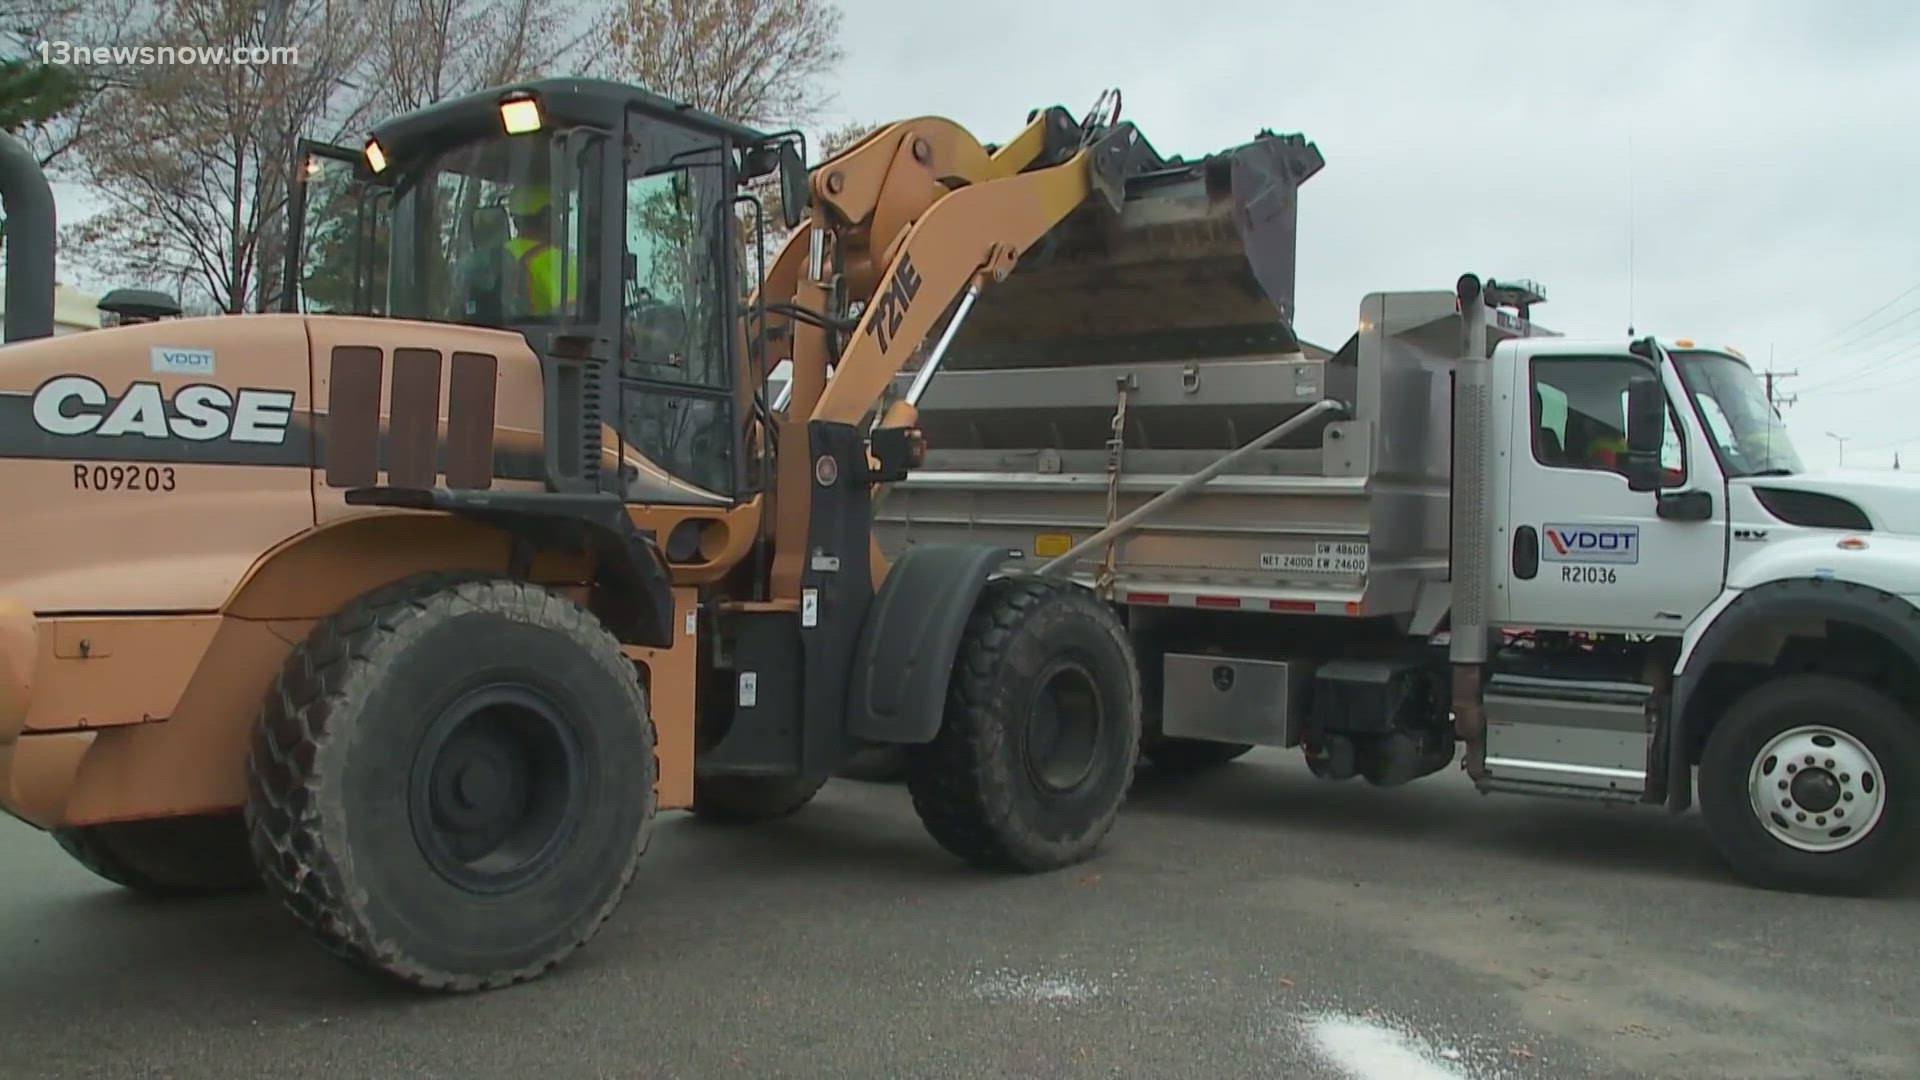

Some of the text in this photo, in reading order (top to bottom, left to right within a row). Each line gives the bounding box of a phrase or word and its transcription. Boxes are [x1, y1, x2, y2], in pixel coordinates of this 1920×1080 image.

[866, 250, 921, 354] 721E
[163, 352, 211, 365] VDOT
[32, 373, 296, 445] CASE
[73, 464, 176, 491] R09203
[1317, 543, 1366, 556] GW 48600
[1560, 531, 1637, 550] VDOT
[1262, 555, 1365, 571] NET 24000 EW 24600
[1561, 566, 1617, 584] R21036
